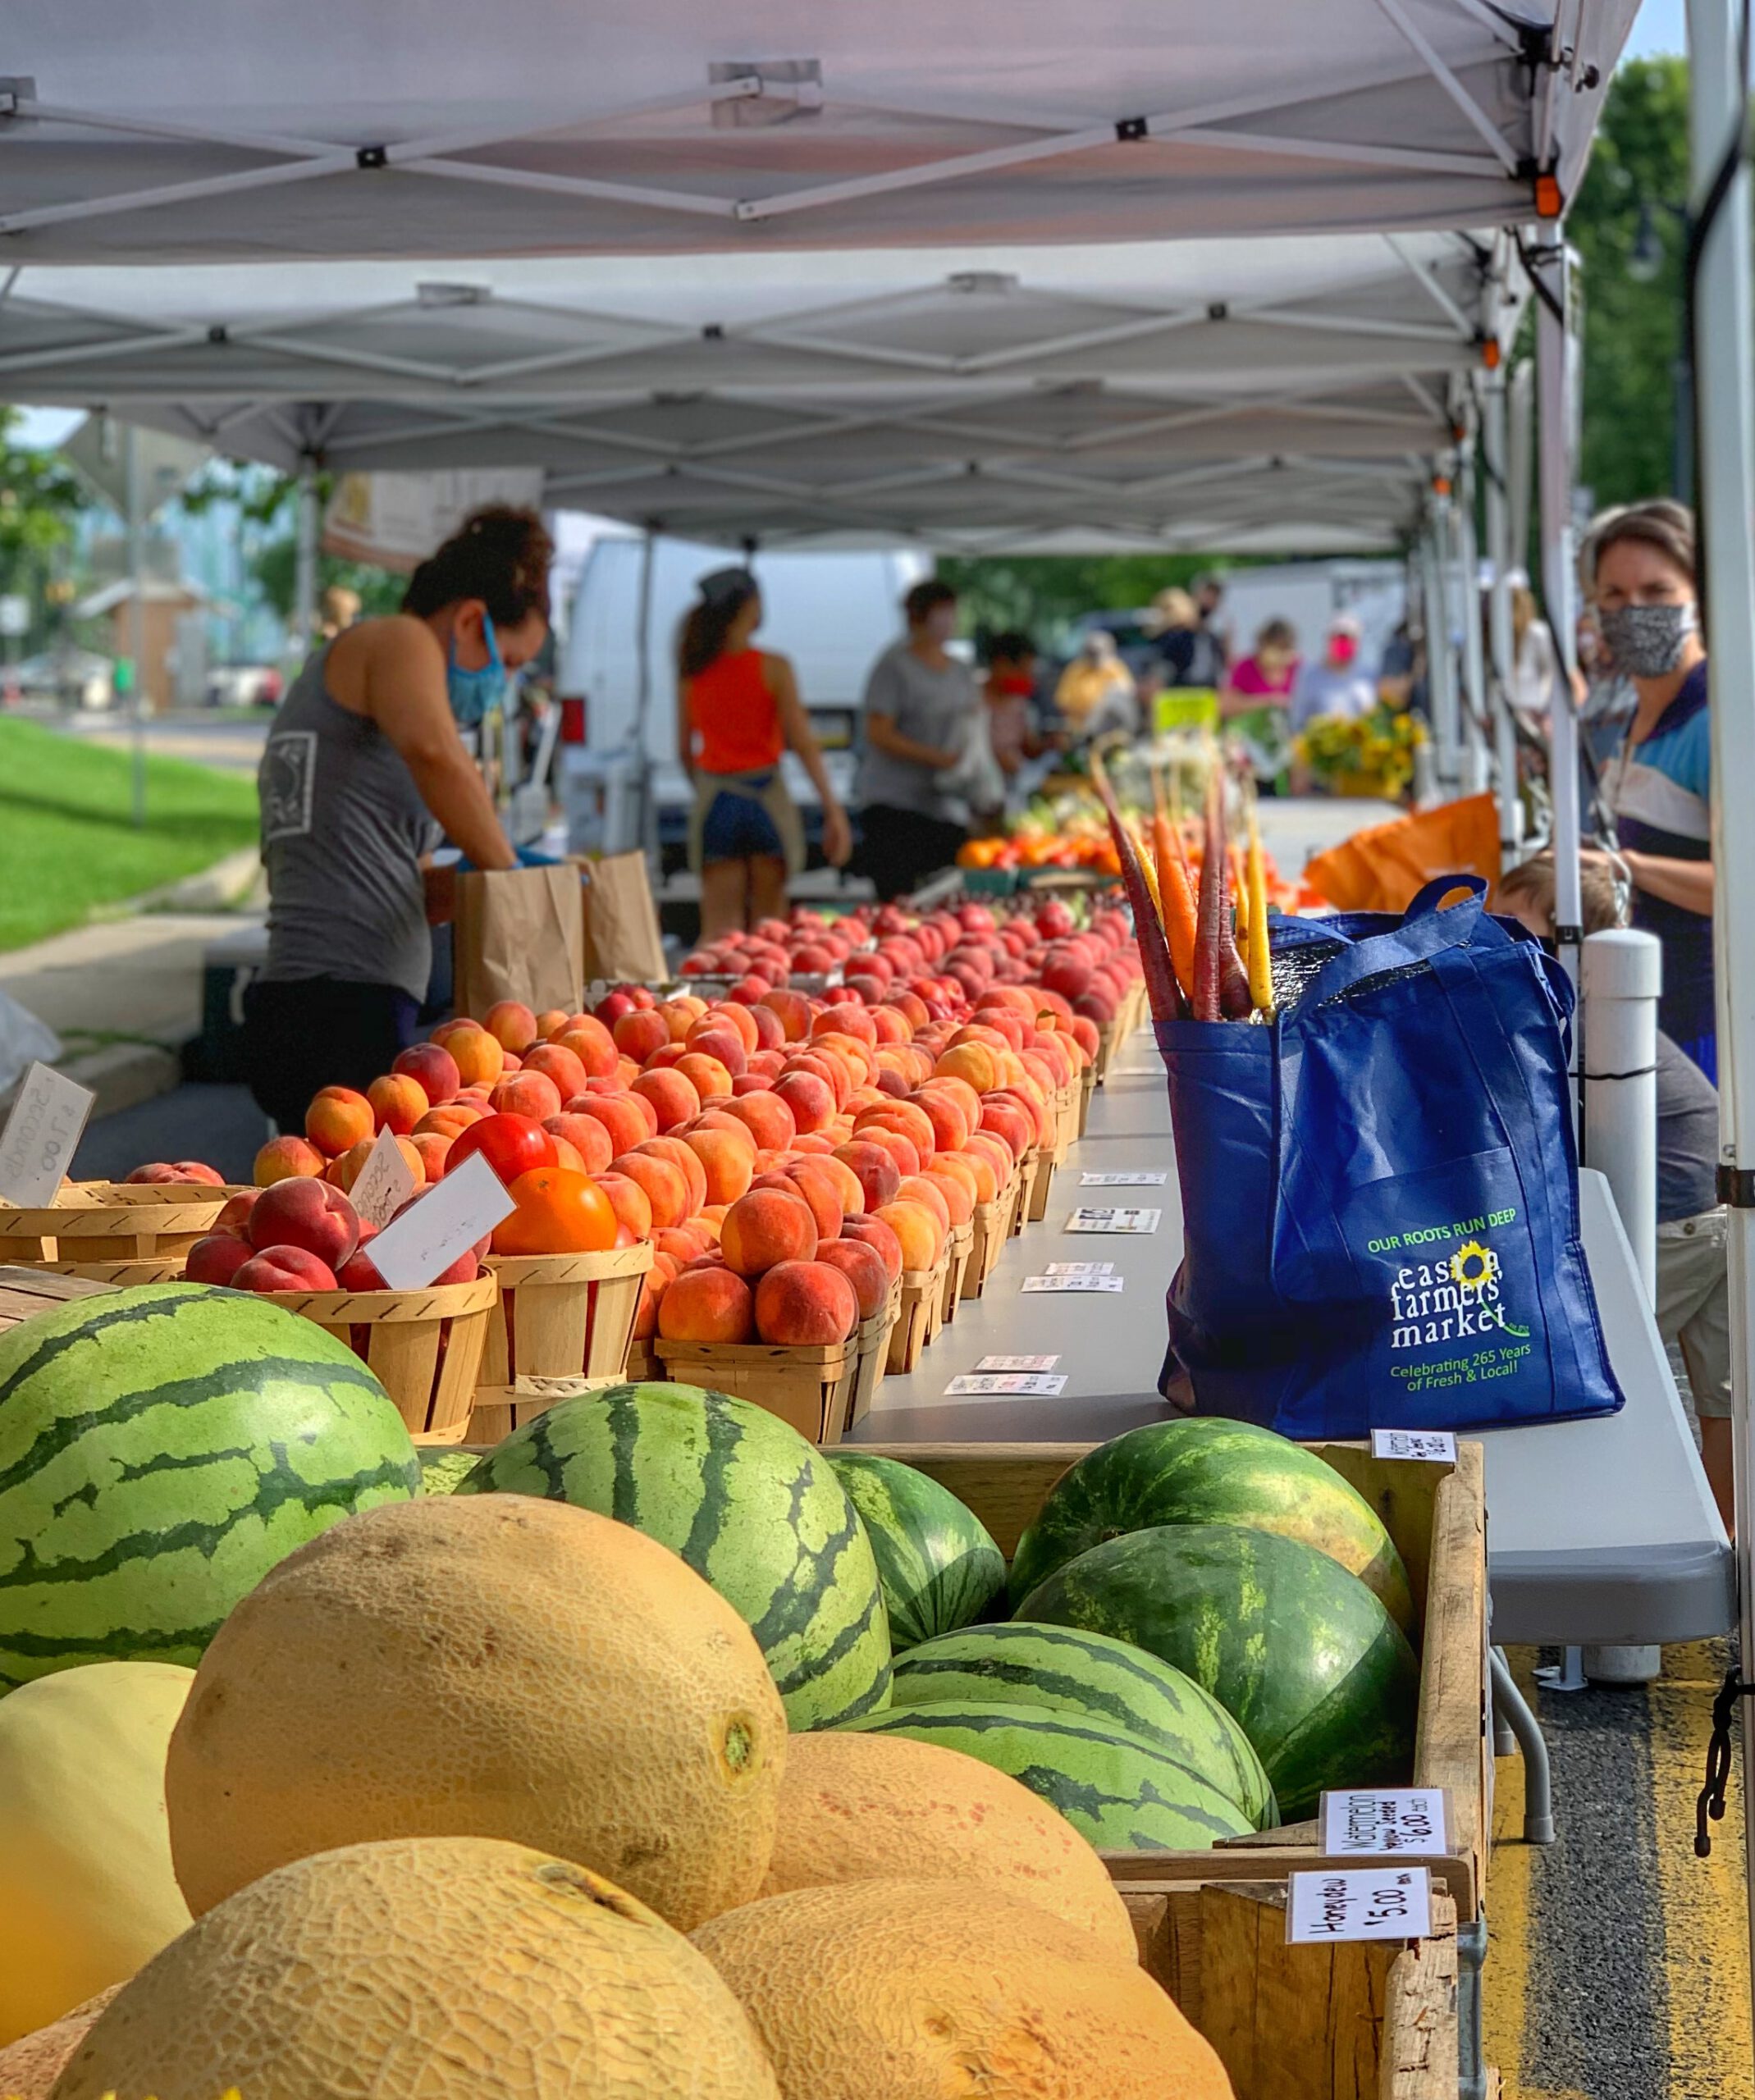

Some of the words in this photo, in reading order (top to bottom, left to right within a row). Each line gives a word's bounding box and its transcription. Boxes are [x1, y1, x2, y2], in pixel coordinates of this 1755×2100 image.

[1368, 1236, 1401, 1253] OUR
[1403, 1226, 1451, 1245] ROOTS
[1453, 1217, 1486, 1236] RUN
[1488, 1208, 1516, 1227] DEEP
[1391, 1303, 1506, 1348] market
[1391, 1358, 1469, 1377] Celebrating
[1473, 1350, 1496, 1367] 265
[1499, 1344, 1531, 1360] Years
[1407, 1378, 1423, 1391] of
[1426, 1372, 1461, 1389] Fresh
[1466, 1369, 1477, 1382] &
[1481, 1360, 1518, 1380] Local!
[1339, 1794, 1376, 1850] Watermelon
[1308, 1878, 1358, 1934] Honeydew
